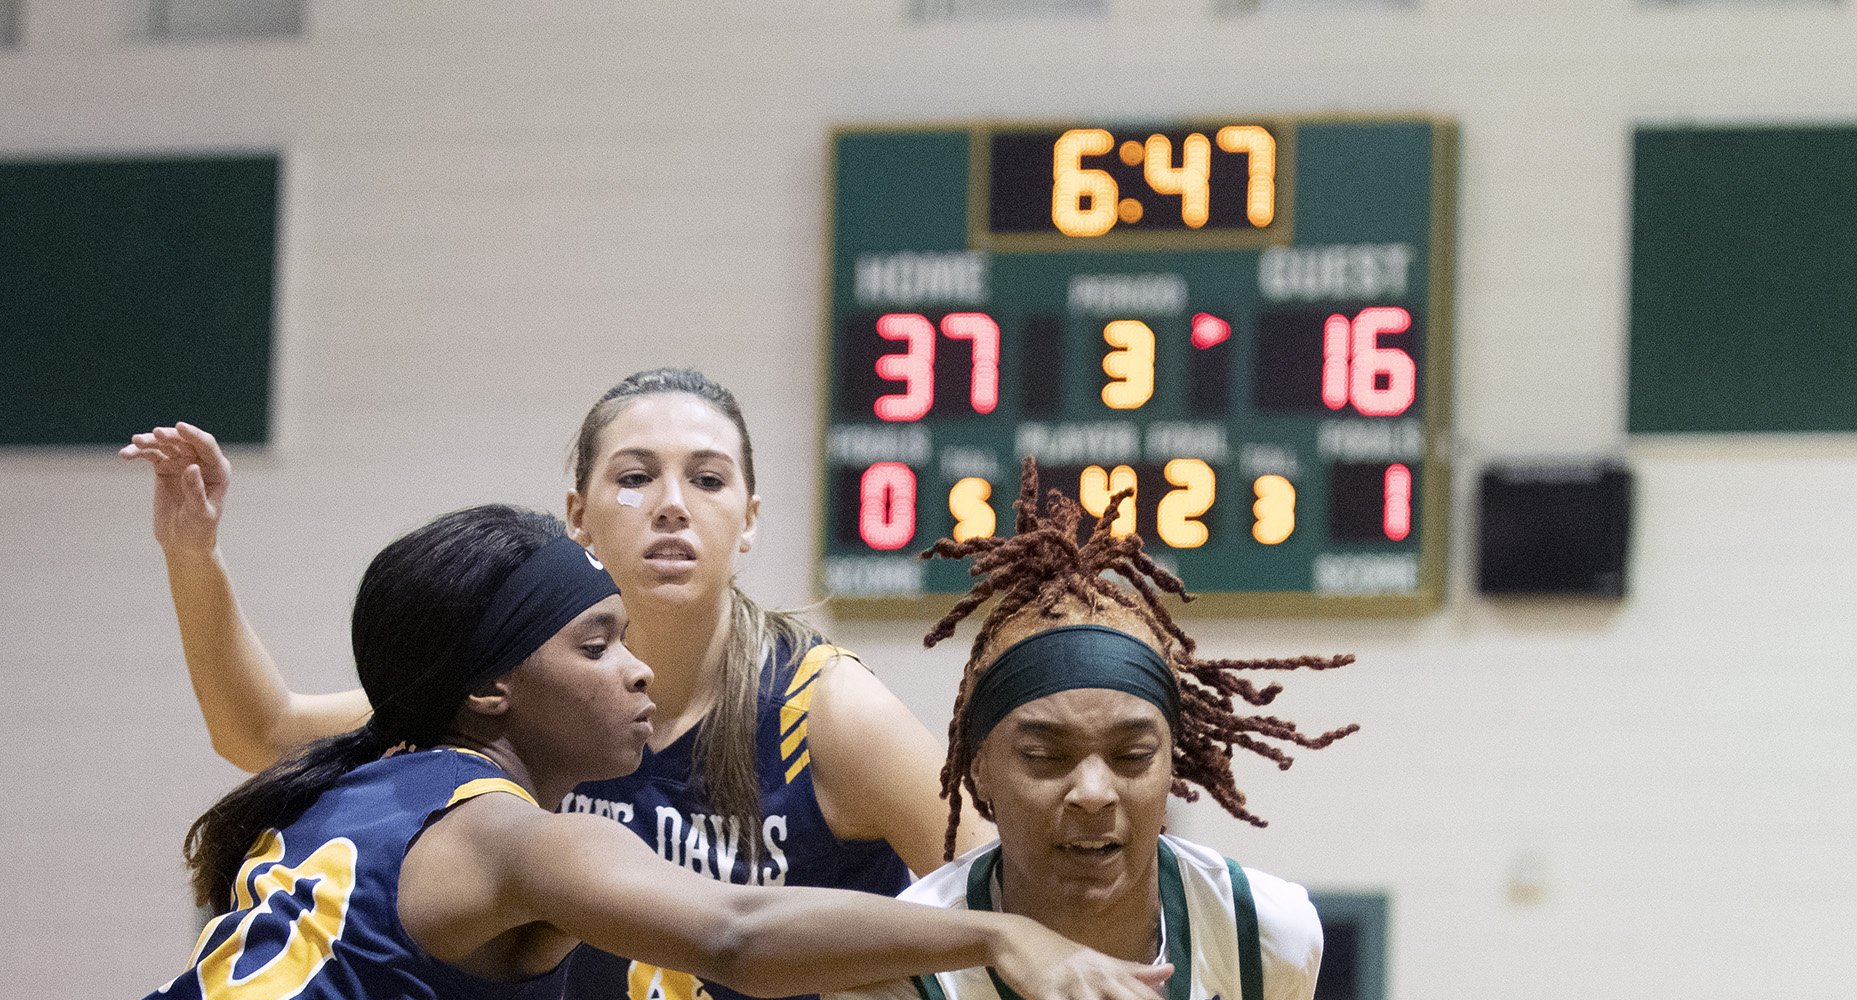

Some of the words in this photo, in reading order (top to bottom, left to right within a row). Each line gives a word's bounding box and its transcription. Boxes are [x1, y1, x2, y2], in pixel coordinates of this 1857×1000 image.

[1052, 125, 1276, 237] 6:47
[875, 312, 1000, 421] 37
[1101, 320, 1155, 409] 3
[1322, 307, 1416, 416] 16
[860, 462, 917, 550] 0
[1253, 475, 1296, 544] 3
[1383, 464, 1412, 541] 1
